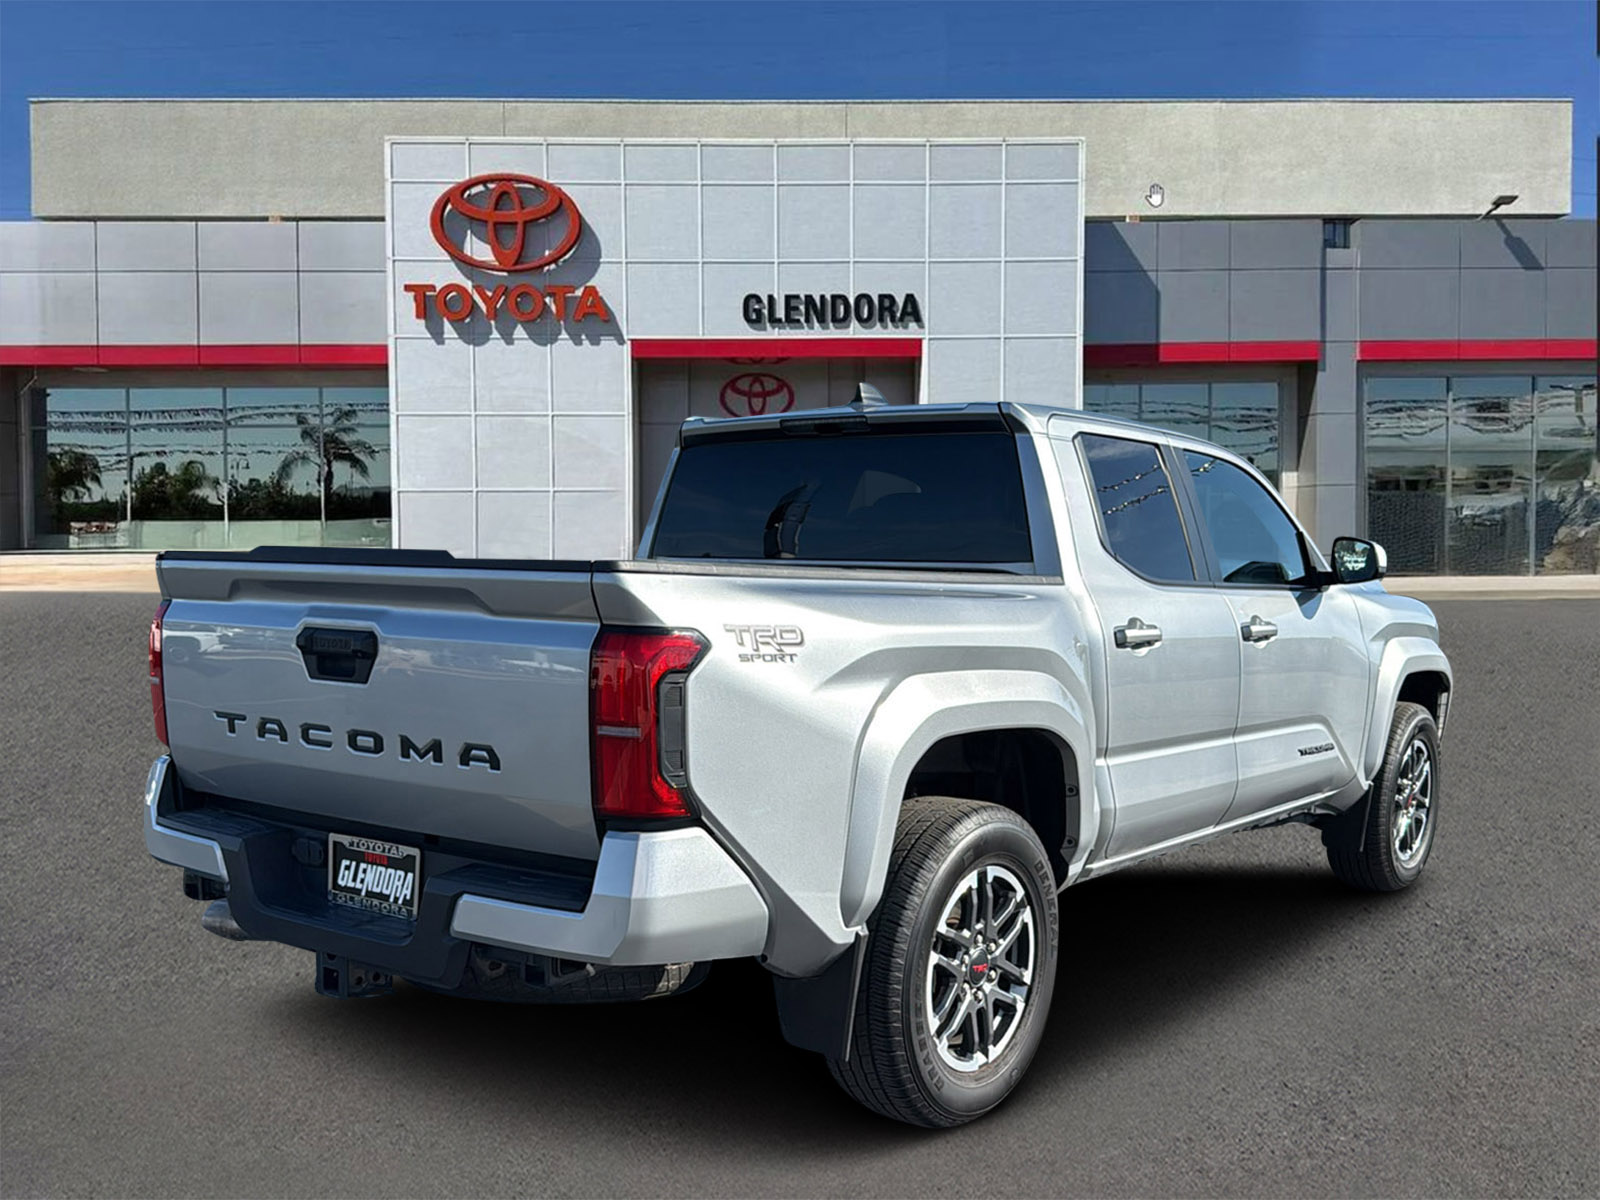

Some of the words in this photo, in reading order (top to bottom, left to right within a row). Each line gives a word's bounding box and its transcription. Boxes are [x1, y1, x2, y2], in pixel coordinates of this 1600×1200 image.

[404, 283, 610, 323] TOYOTA
[742, 293, 923, 326] GLENDORA
[723, 624, 804, 652] TRD
[738, 653, 798, 663] SPORT
[213, 710, 502, 772] TACOMA
[351, 839, 401, 857] TOYOTA
[337, 858, 414, 904] GLENDORA
[336, 893, 409, 917] GLENDORA
